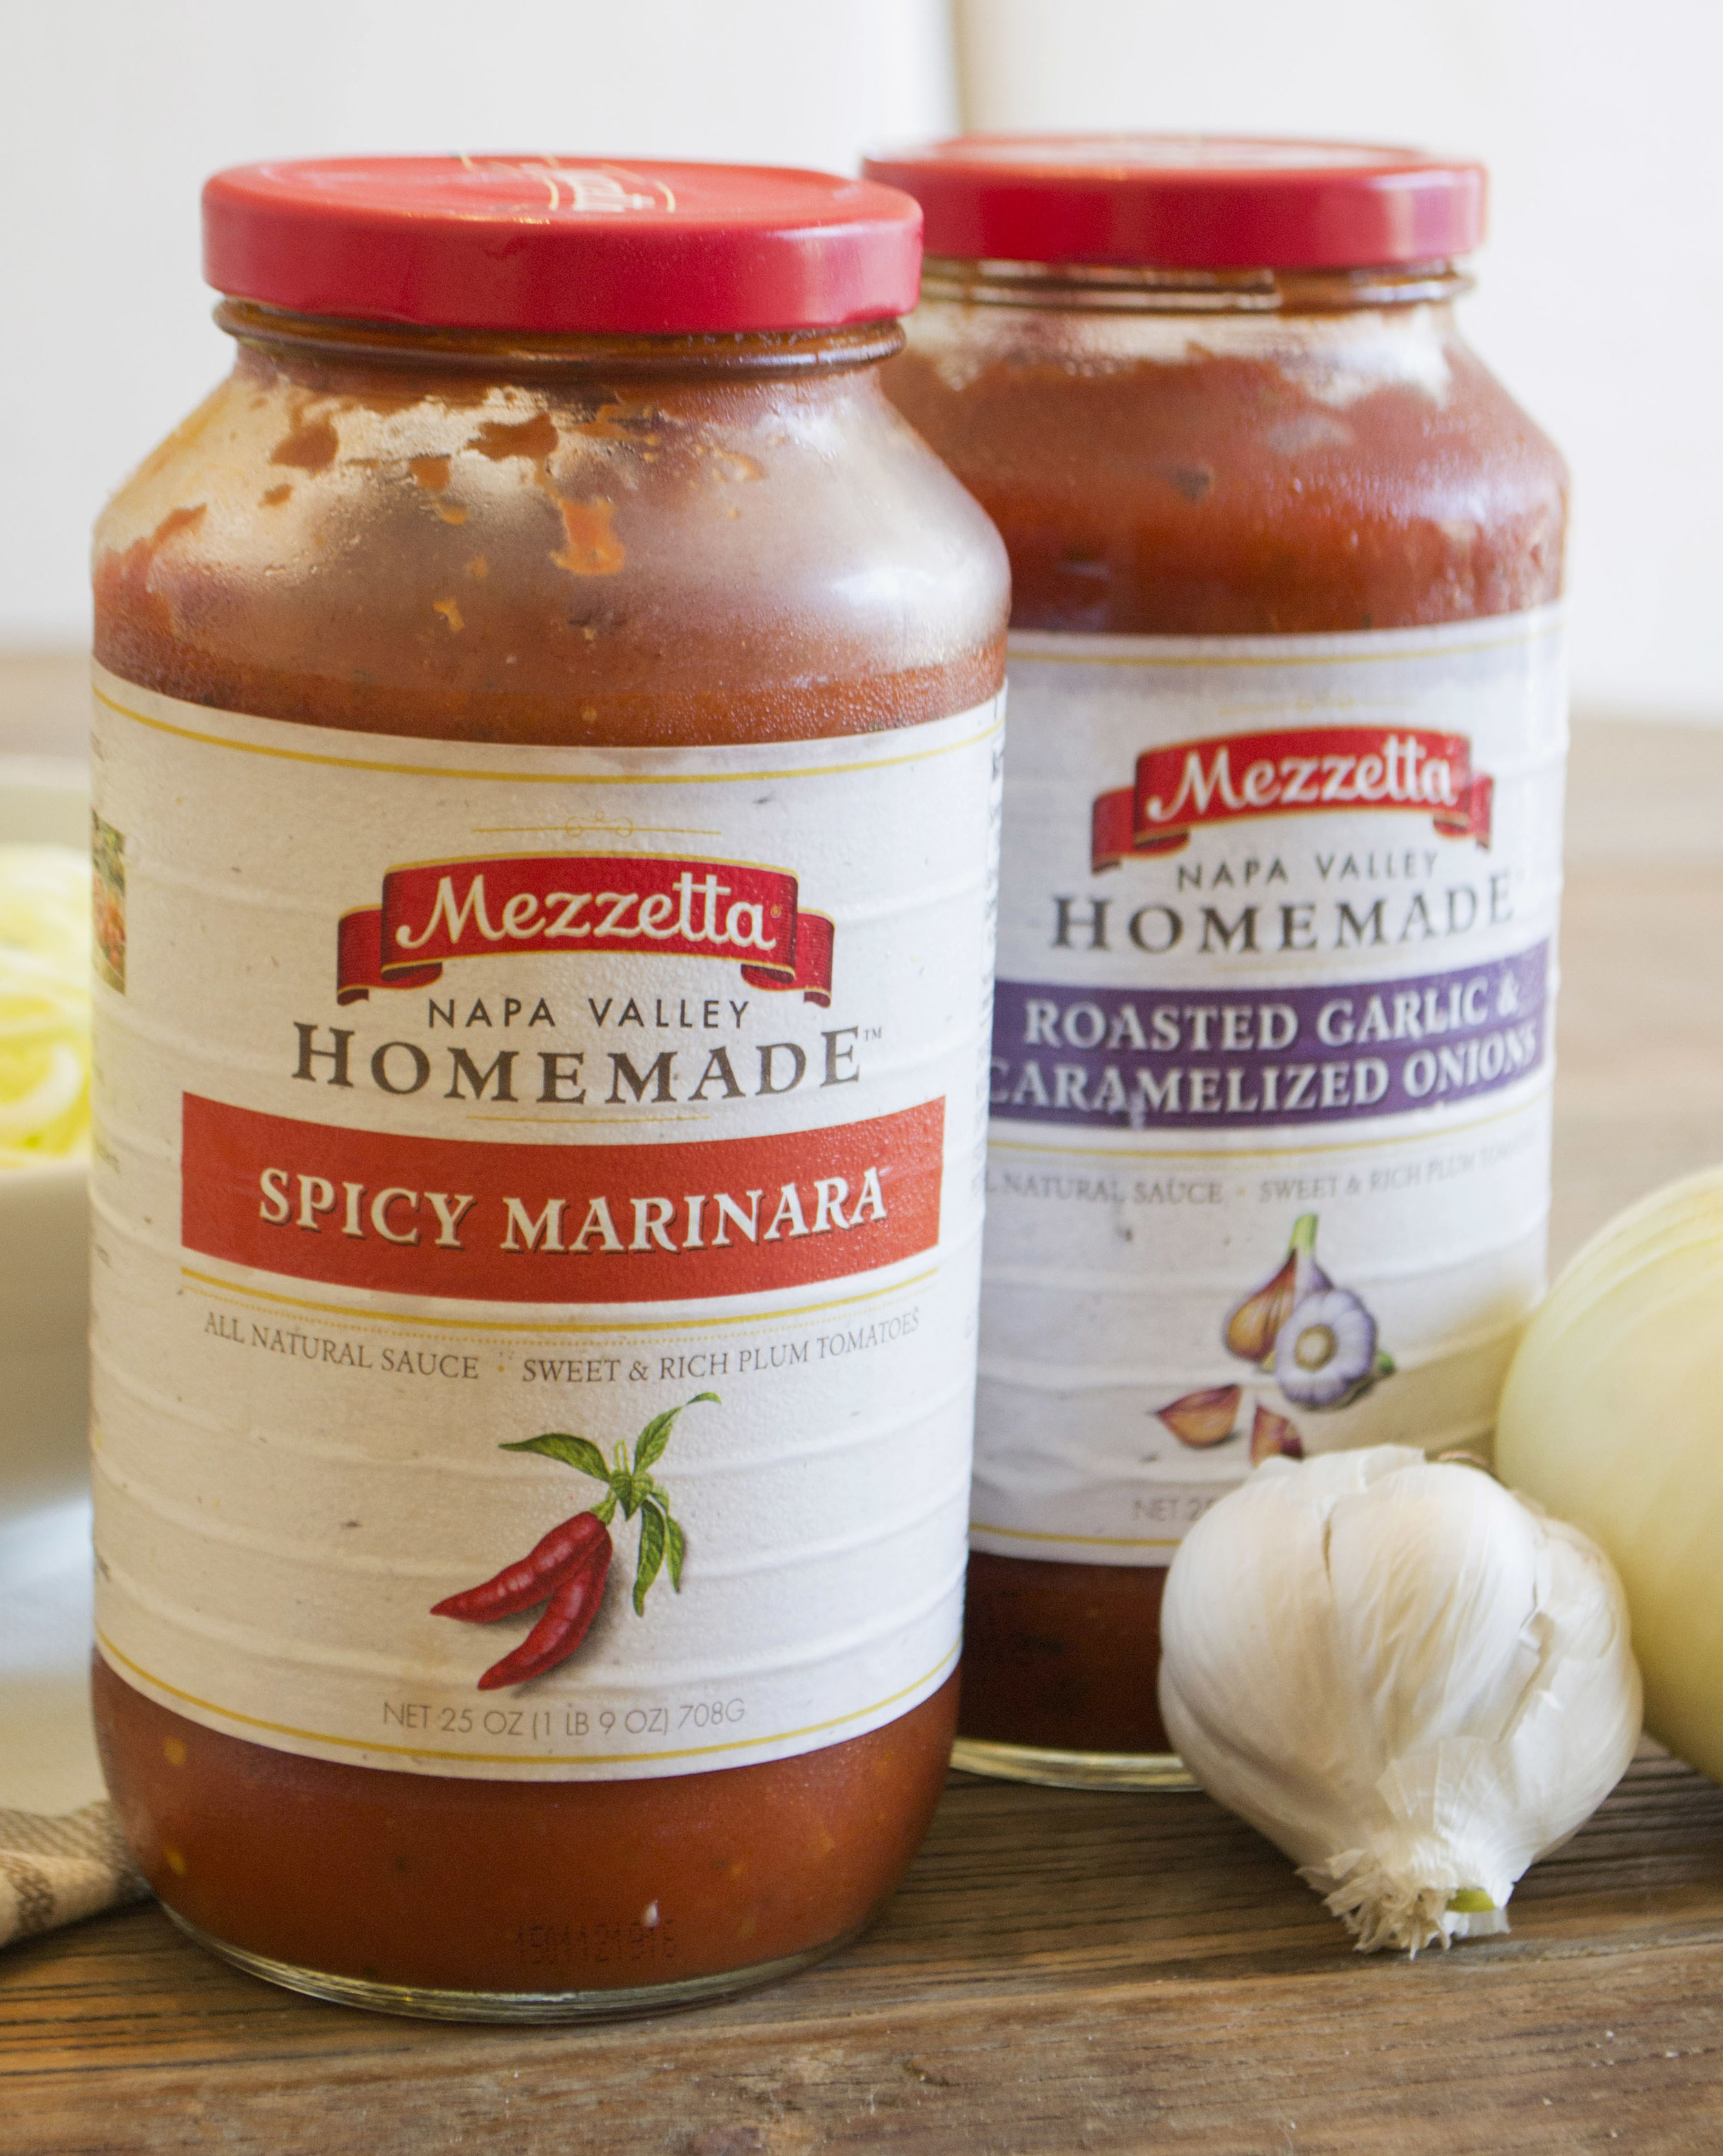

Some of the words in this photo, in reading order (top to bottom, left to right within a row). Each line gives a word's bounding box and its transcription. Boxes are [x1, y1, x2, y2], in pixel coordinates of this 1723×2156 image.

[1145, 734, 1459, 822] Mezzetta
[1178, 857, 1289, 892] NAPA
[1315, 849, 1439, 881] VALLEY
[395, 871, 778, 950] Mezzetta
[1051, 869, 1514, 956] HOMEMADE
[427, 997, 555, 1028] NAPA
[588, 997, 751, 1028] VALLEY
[1023, 997, 1301, 1053] ROASTED
[1316, 975, 1490, 1048] GARLIC
[1497, 976, 1518, 1019] &
[291, 1021, 861, 1106] HOMEMADE
[1402, 1023, 1538, 1099] ONIONS
[258, 1167, 477, 1251] SPICY
[499, 1166, 889, 1256] MARINARA
[1003, 1170, 1126, 1203] NATURAL
[1133, 1174, 1223, 1205] SAUCE
[1258, 1177, 1340, 1203] SWEET
[1369, 1163, 1422, 1193] RICH
[203, 1311, 245, 1344] ALL
[251, 1323, 373, 1370] NATURAL
[380, 1347, 480, 1381] SAUCE
[522, 1358, 620, 1383] SWEET
[628, 1359, 649, 1381] &
[660, 1352, 728, 1381] RICH
[740, 1341, 809, 1373] PLUM
[818, 1308, 921, 1361] TOMATOES
[383, 1701, 431, 1729] NET
[440, 1708, 473, 1733] 25
[483, 1711, 523, 1737] OZ
[565, 1711, 589, 1737] LB
[599, 1711, 617, 1735] 9
[624, 1708, 670, 1737] OZ)
[678, 1698, 746, 1730] 708G
